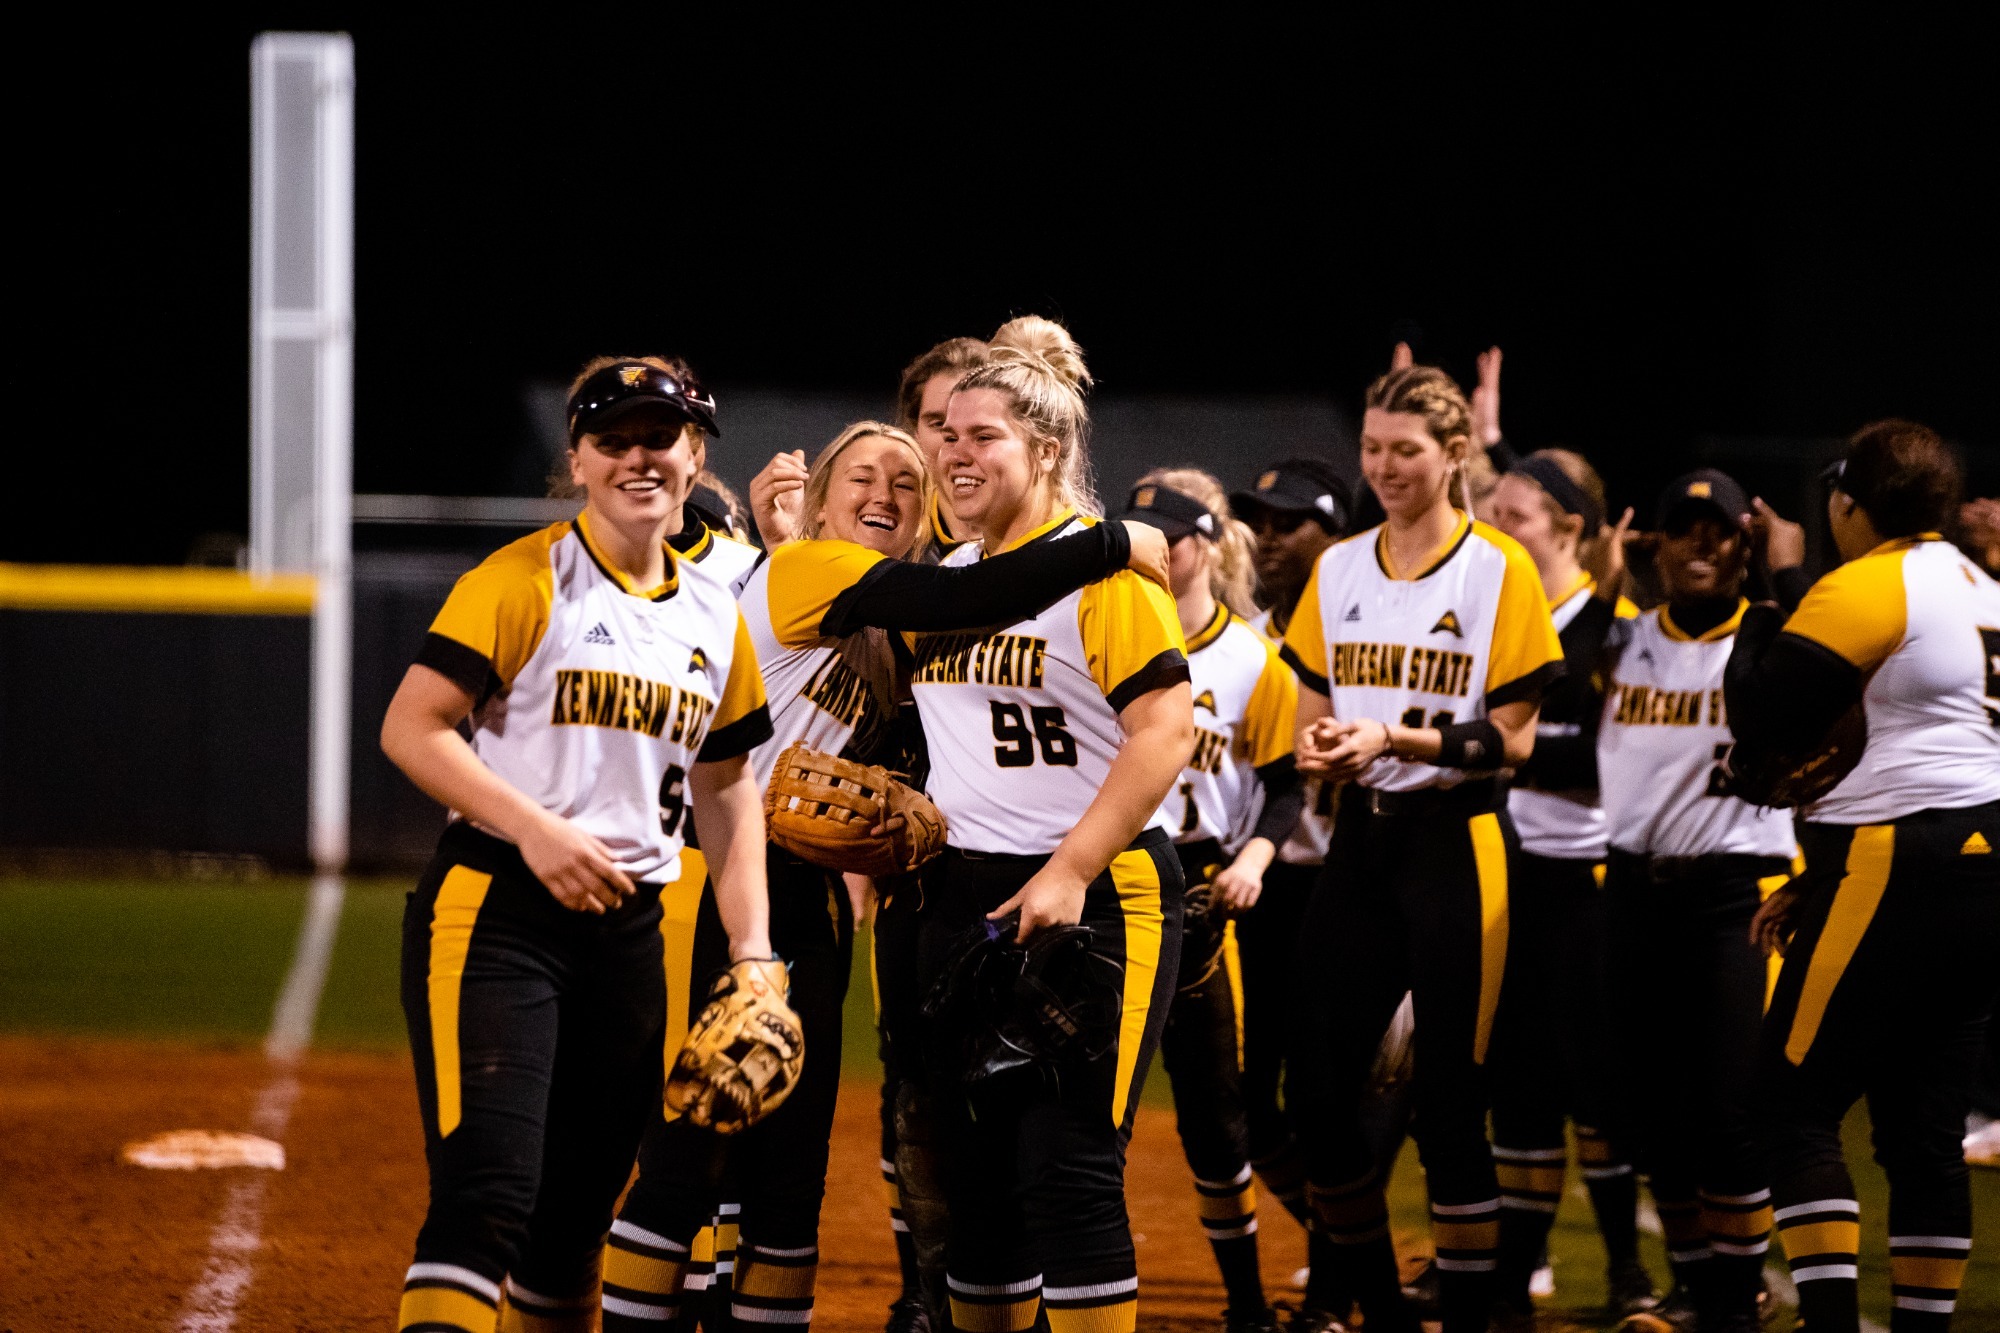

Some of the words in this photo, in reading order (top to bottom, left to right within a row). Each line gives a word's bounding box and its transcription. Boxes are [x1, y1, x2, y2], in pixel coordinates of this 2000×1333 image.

[974, 634, 1049, 689] STATE
[1407, 646, 1473, 697] STATE
[551, 669, 672, 739] KENNESAW
[989, 699, 1078, 768] 96
